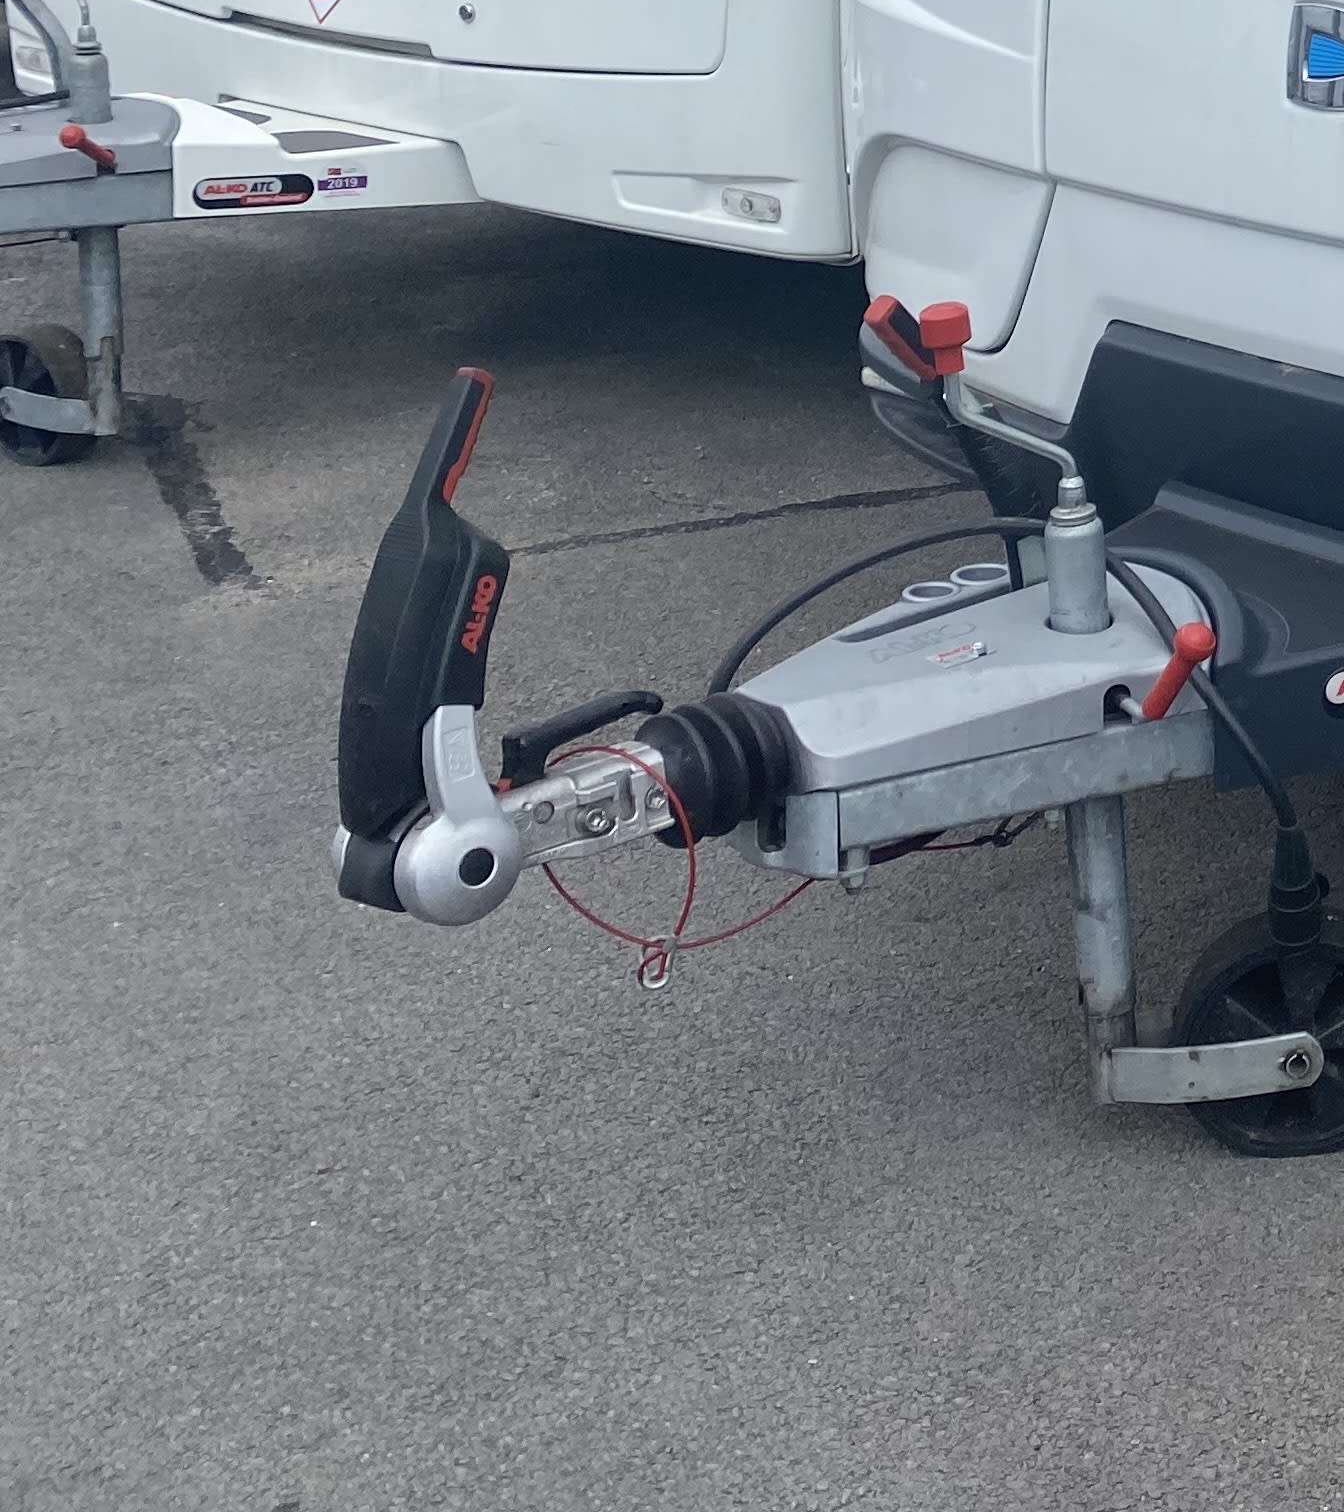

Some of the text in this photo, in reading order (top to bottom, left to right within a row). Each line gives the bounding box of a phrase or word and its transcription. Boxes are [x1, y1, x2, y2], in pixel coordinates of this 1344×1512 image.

[250, 181, 275, 192] ATC
[327, 178, 358, 189] 2019
[461, 574, 498, 654] AL-KO
